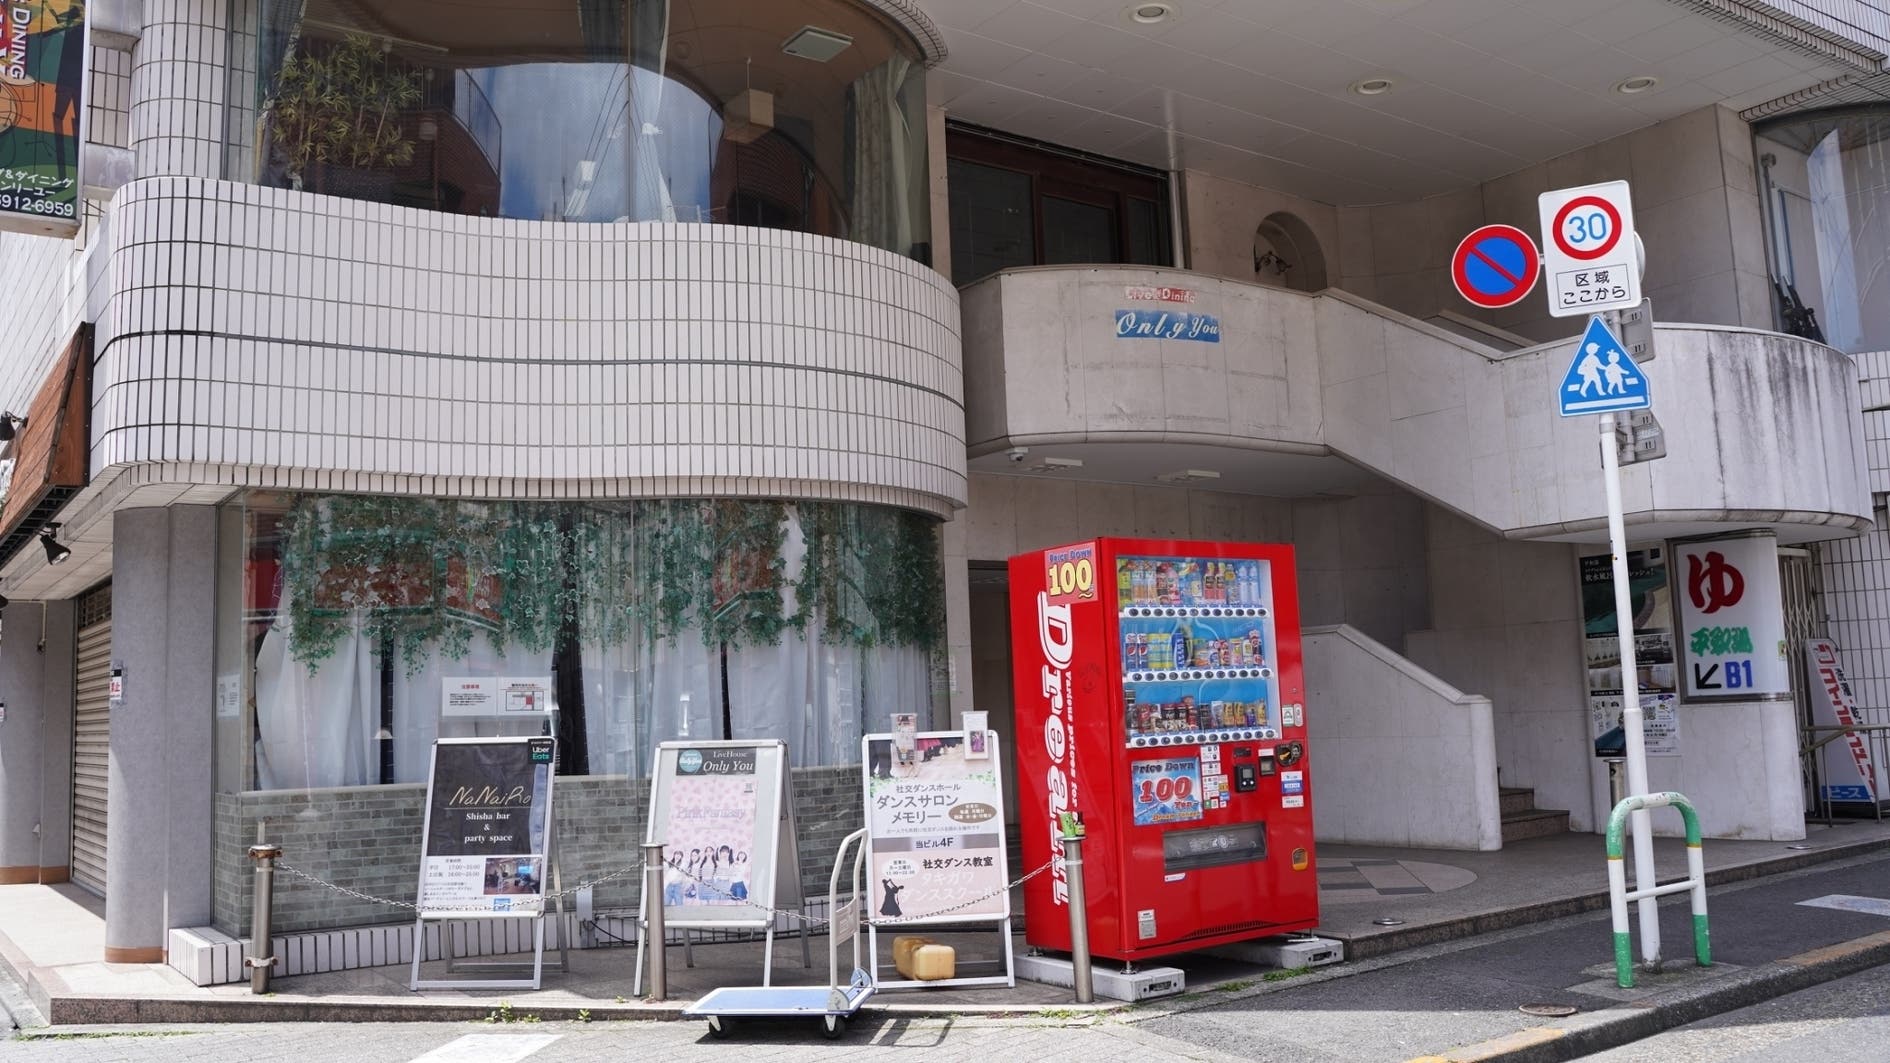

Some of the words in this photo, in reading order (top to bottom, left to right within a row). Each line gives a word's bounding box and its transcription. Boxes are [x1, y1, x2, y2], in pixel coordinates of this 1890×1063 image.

[10, 7, 31, 79] DINING
[0, 194, 74, 216] 912-6959
[1568, 212, 1607, 243] 30
[1575, 270, 1610, 287] 区域
[1563, 287, 1626, 305] ここから
[1117, 312, 1186, 339] Only
[1188, 317, 1219, 338] You
[1048, 558, 1094, 597] 100
[1686, 551, 1745, 614] ゆ
[1724, 660, 1753, 689] B1
[703, 760, 729, 774] Only
[733, 760, 754, 771] You
[896, 783, 961, 793] 社交ダンスホール
[1139, 775, 1195, 804] 100
[876, 794, 959, 810] ダンスサロン
[466, 811, 493, 821] Shisha
[495, 811, 511, 820] bar
[891, 810, 942, 824] メモリー
[483, 823, 491, 831] &
[464, 835, 486, 845] party
[489, 835, 513, 844] space
[915, 837, 955, 849] 当ビル4F
[922, 856, 994, 870] 社交ダンス教室
